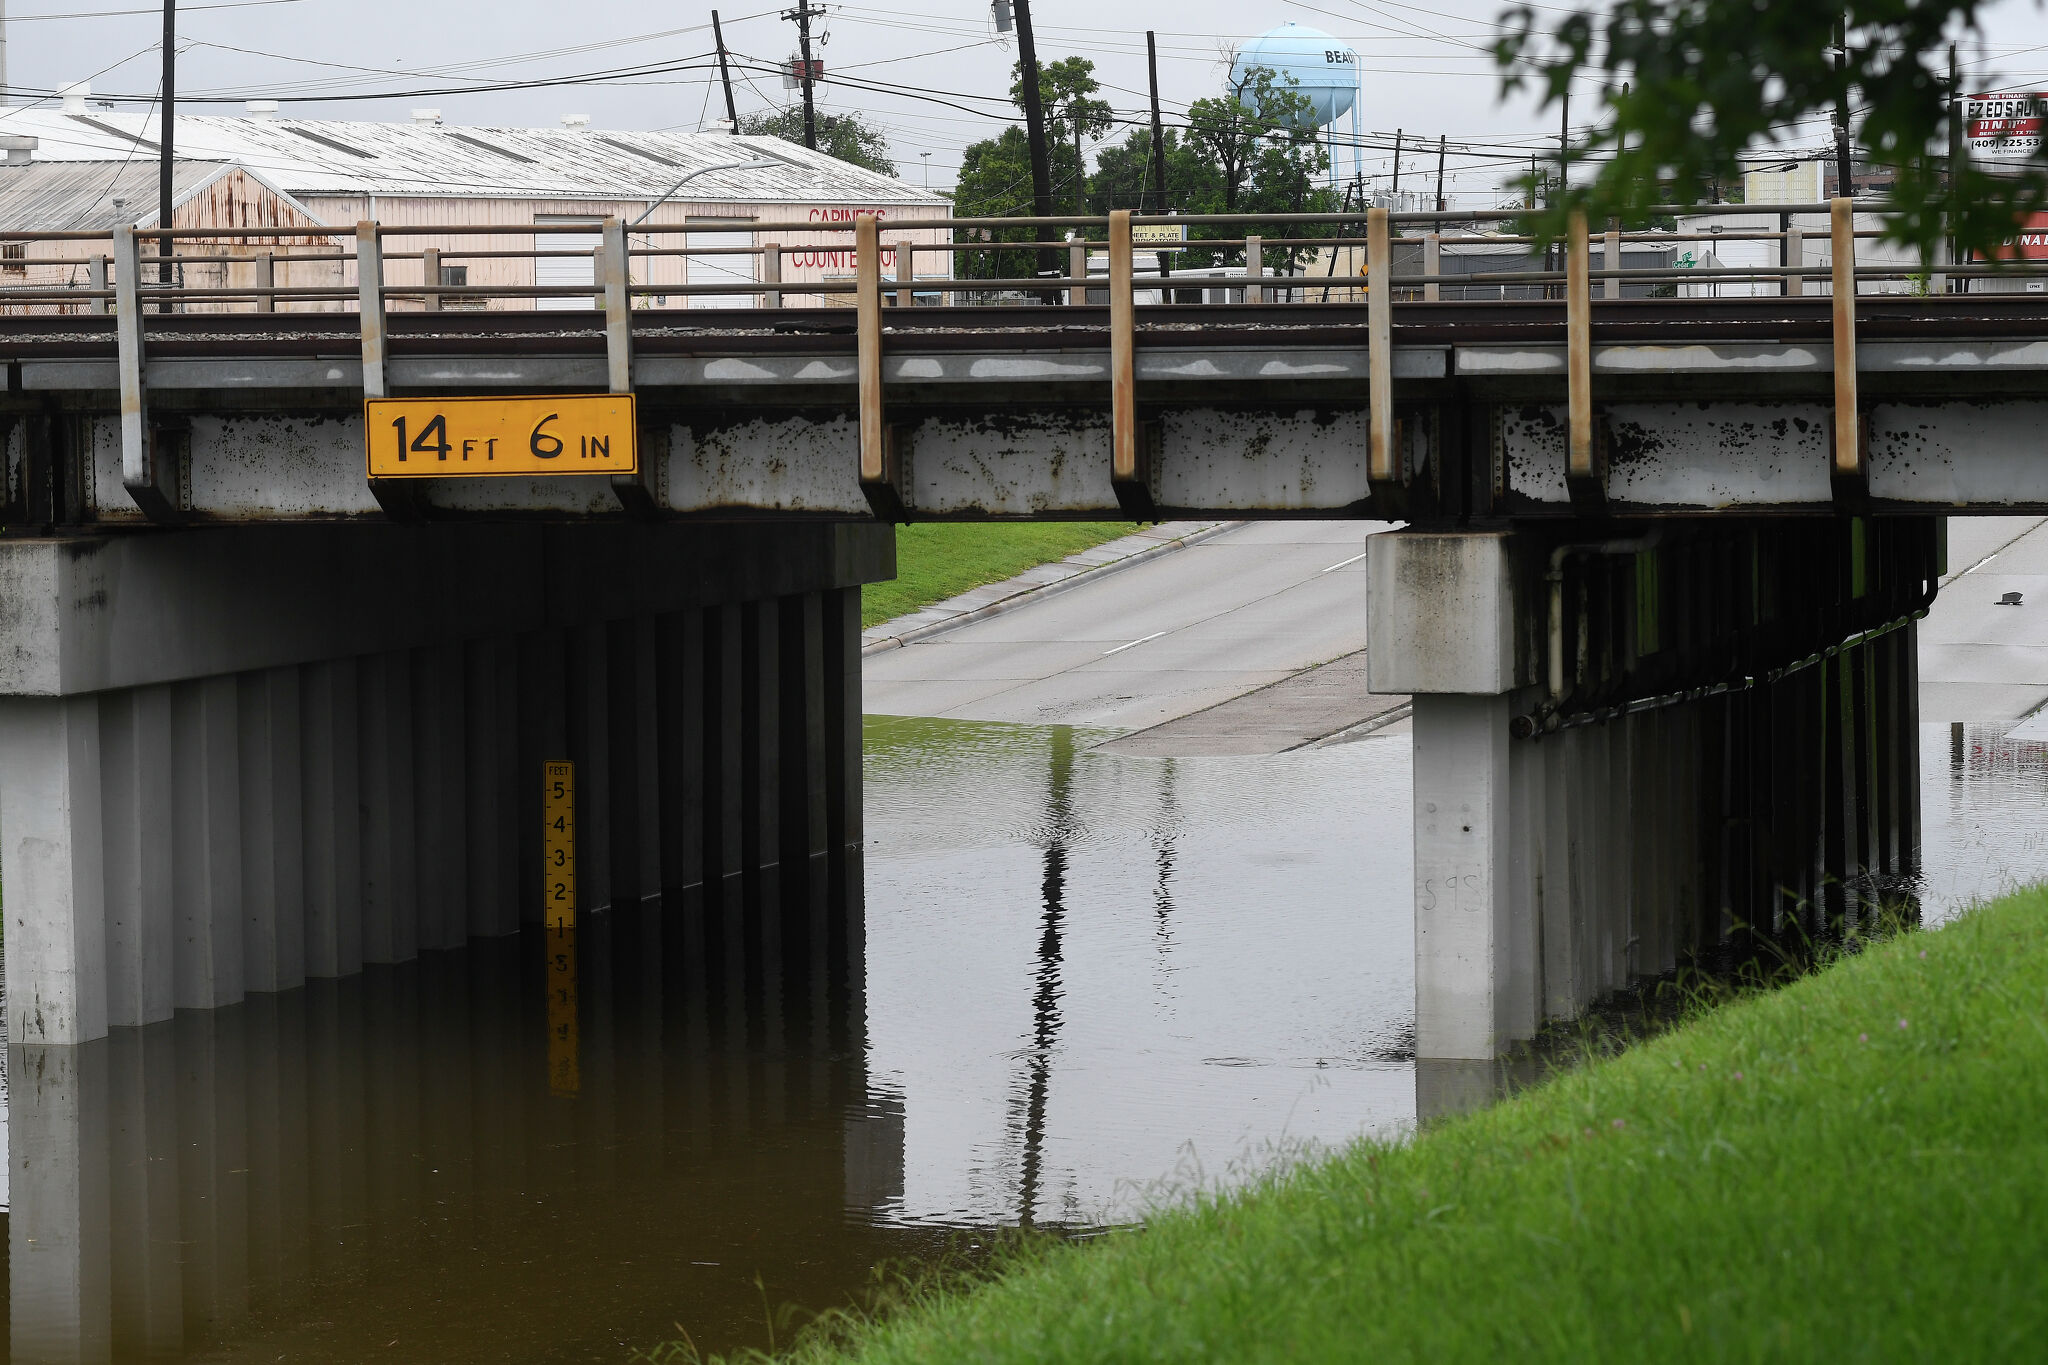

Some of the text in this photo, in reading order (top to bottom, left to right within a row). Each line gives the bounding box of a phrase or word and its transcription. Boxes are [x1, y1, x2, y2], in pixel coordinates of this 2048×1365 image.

[1968, 102, 1984, 118] EZ
[1971, 139, 1999, 150] (409)
[392, 412, 610, 462] 14 FT 6 IN
[549, 766, 569, 776] FEET
[553, 781, 565, 799] 5
[553, 815, 565, 832] 4
[554, 849, 565, 867] 3
[554, 883, 566, 900] 2
